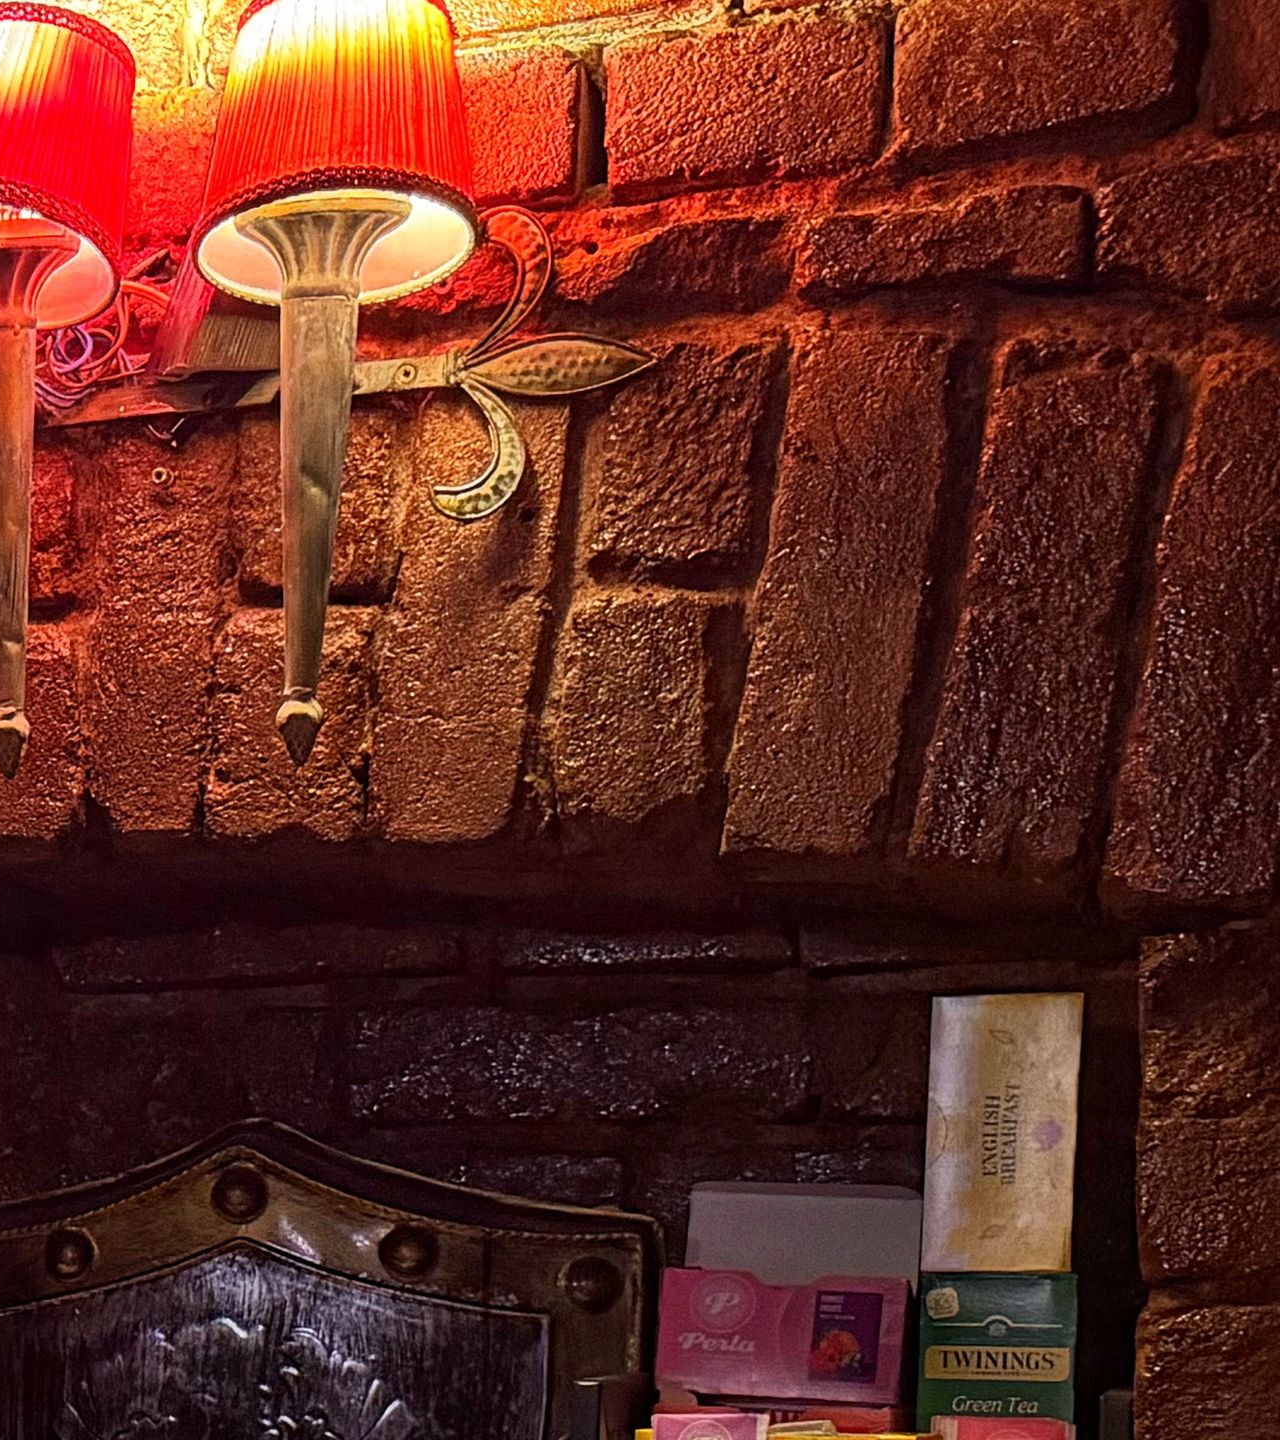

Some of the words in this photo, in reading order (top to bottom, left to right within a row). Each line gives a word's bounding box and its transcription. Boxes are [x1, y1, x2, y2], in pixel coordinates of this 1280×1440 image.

[981, 1095, 1001, 1177] ENGLISH
[999, 1081, 1020, 1185] BREAKFAST
[677, 1331, 756, 1354] Perla
[939, 1349, 1056, 1371] TWININGS
[951, 1395, 1003, 1413] Green
[1006, 1396, 1040, 1414] Tea
